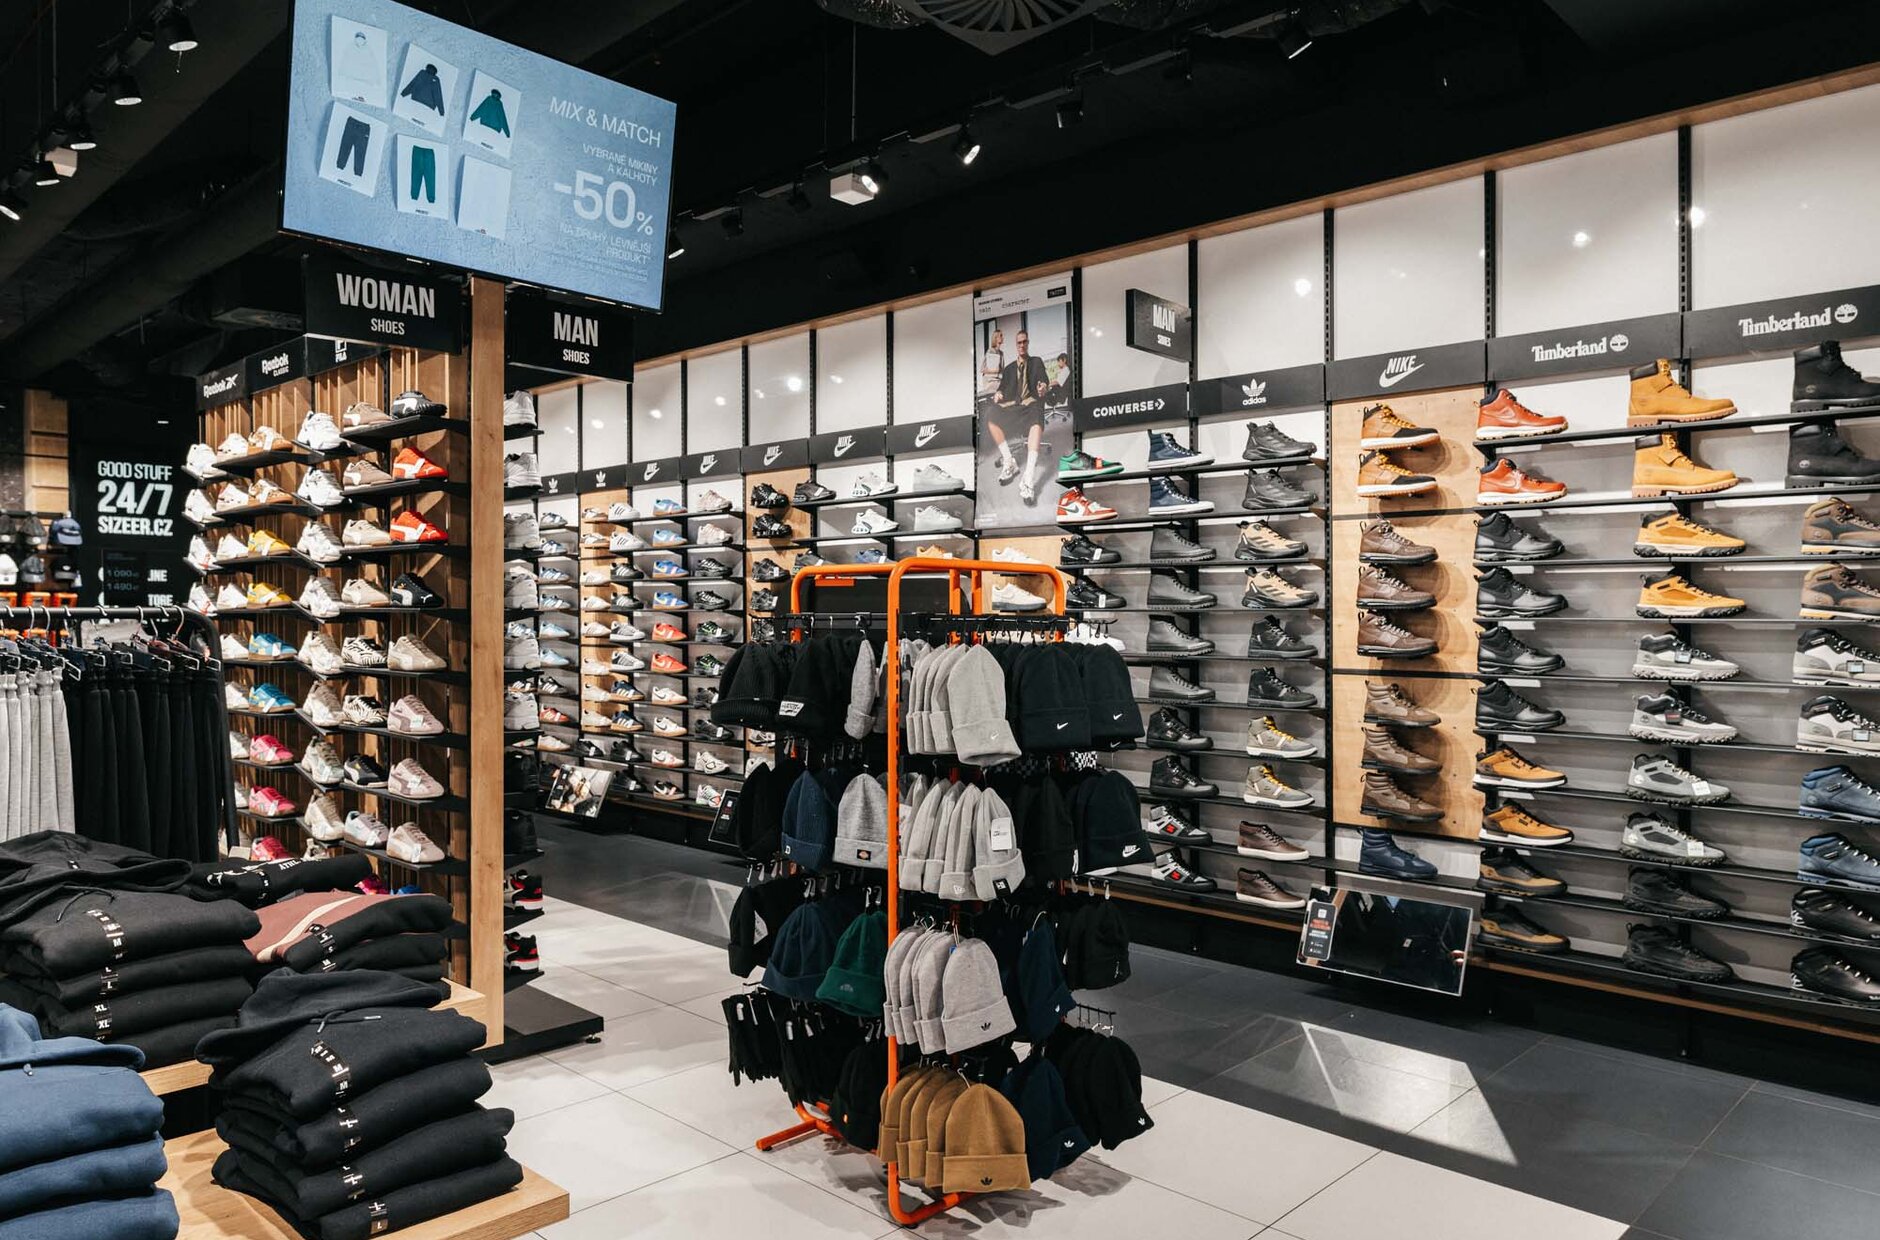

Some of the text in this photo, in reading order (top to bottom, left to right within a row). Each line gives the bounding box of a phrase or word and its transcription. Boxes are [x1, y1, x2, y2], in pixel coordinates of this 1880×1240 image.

[549, 96, 661, 148] MIX & MATCH
[616, 166, 658, 186] KALHOTY
[336, 273, 435, 319] WOMAN
[370, 317, 405, 336] SHOES
[1152, 304, 1175, 333] MAN
[1739, 308, 1832, 337] Timberland
[553, 312, 598, 347] MAN
[562, 348, 590, 365] SHOES
[1531, 336, 1607, 362] Timberland
[261, 353, 289, 375] Reebok
[1386, 355, 1416, 374] NIKE
[203, 379, 226, 398] Reebok
[1093, 401, 1154, 418] CONVERSE
[1242, 396, 1267, 406] adidas
[920, 424, 936, 436] NIKE
[838, 436, 852, 446] NIKE
[98, 460, 172, 481] GOOD STUFF
[98, 479, 173, 516] 24/7
[98, 515, 173, 536] SIZEER.CZ
[113, 937, 122, 947] M
[107, 981, 113, 989] L
[94, 1004, 108, 1012] XL
[98, 1020, 110, 1029] XL
[340, 1081, 348, 1090] M
[377, 1221, 383, 1230] L
